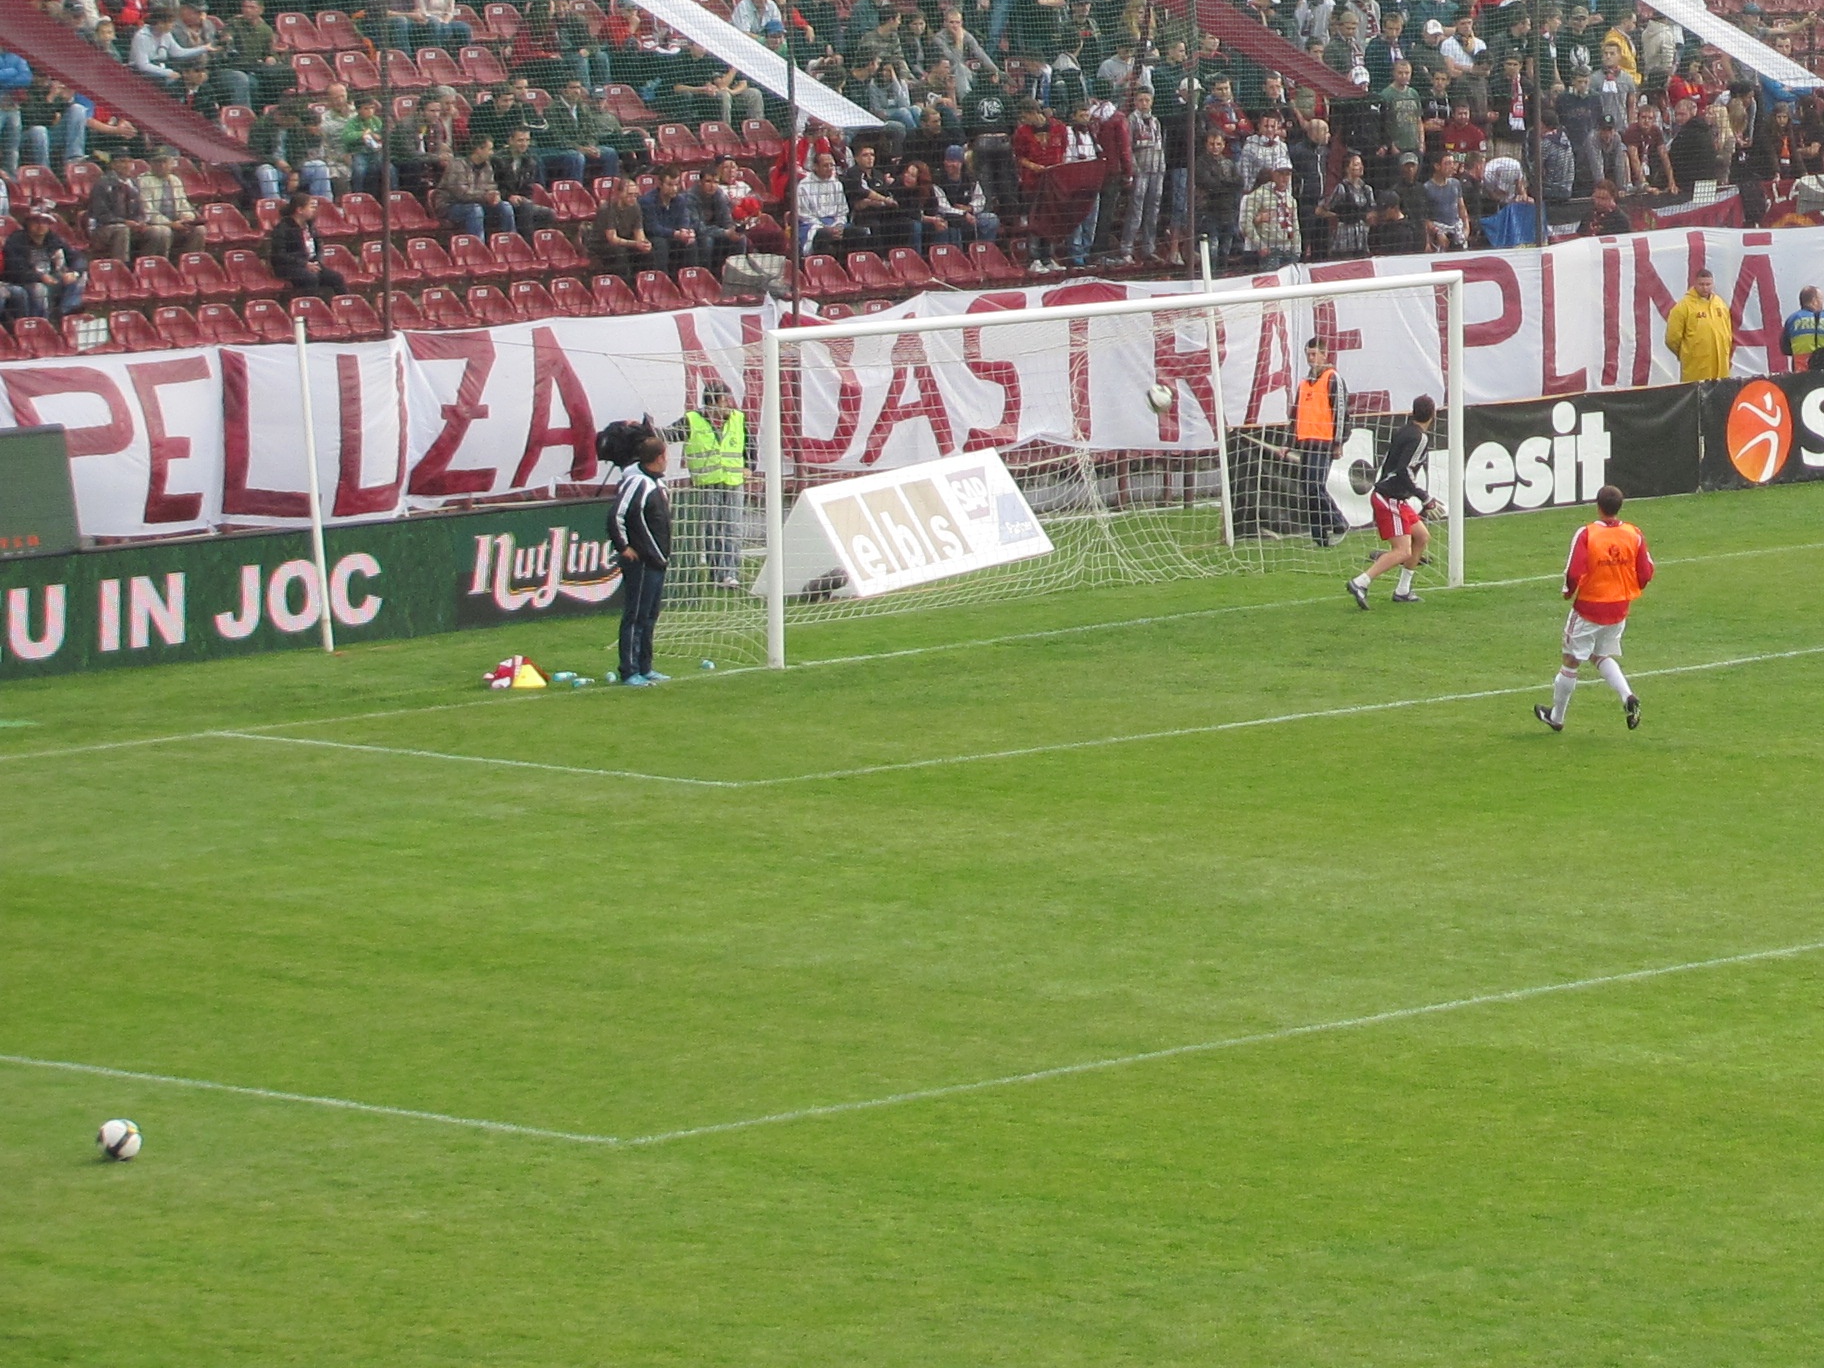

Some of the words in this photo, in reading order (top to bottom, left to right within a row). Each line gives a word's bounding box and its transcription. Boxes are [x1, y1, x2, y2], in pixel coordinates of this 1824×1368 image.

[851, 511, 964, 578] ebs
[100, 572, 187, 652] IN
[214, 552, 384, 641] JOC
